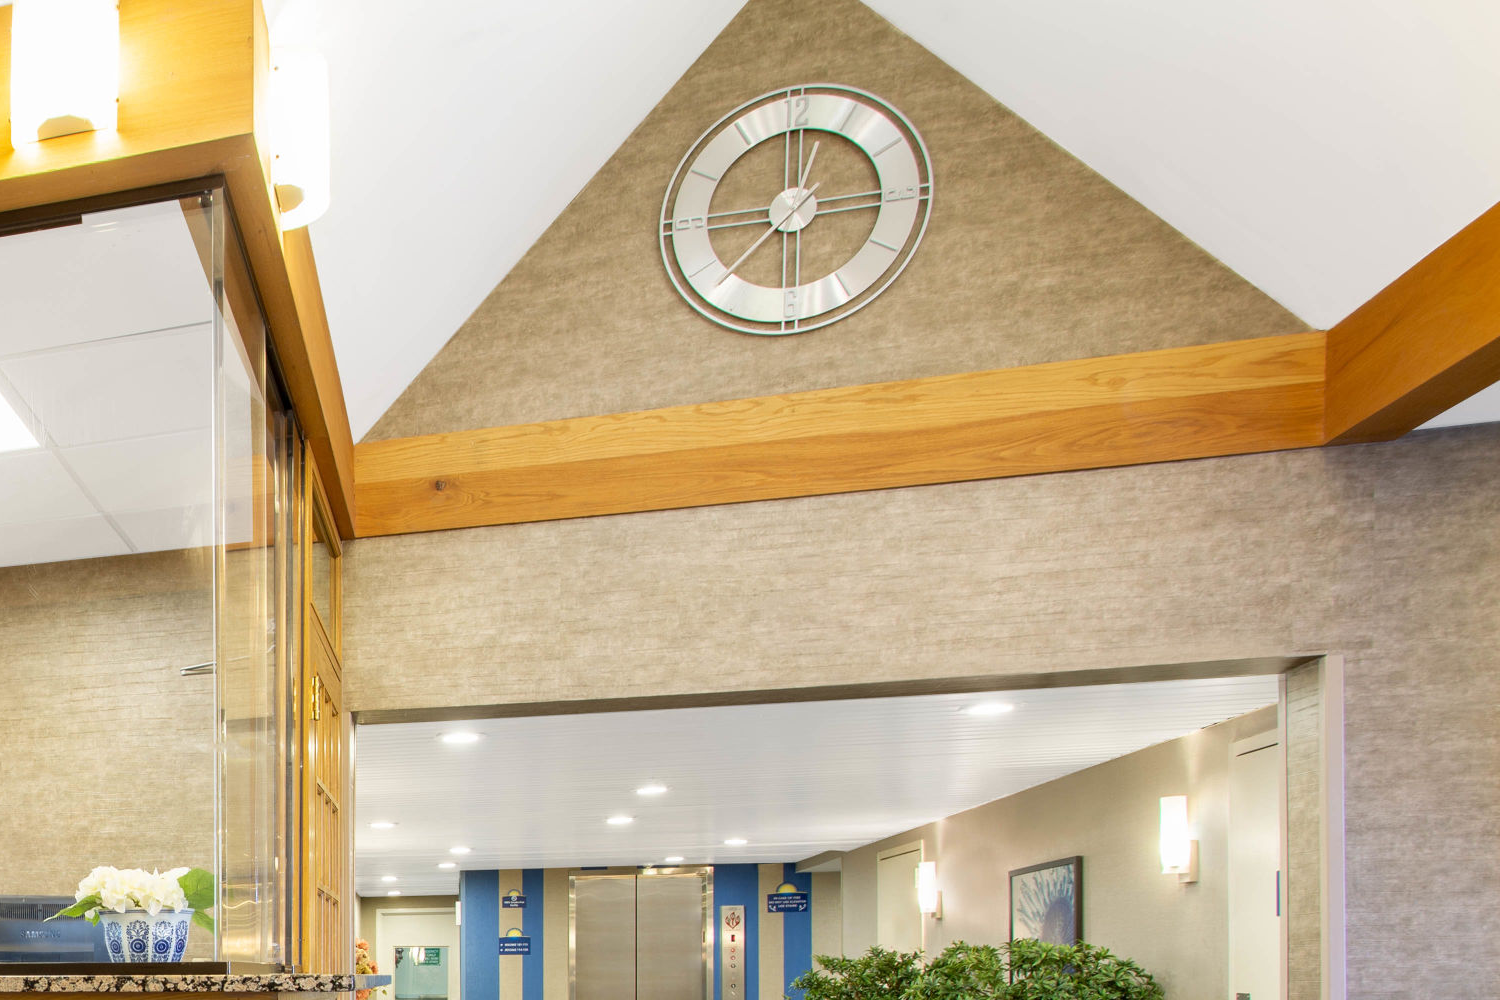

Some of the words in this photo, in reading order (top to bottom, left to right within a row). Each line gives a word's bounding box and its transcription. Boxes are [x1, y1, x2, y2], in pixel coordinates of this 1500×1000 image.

[783, 96, 810, 128] 12
[783, 289, 797, 318] 6
[20, 929, 61, 938] SAMSUNG
